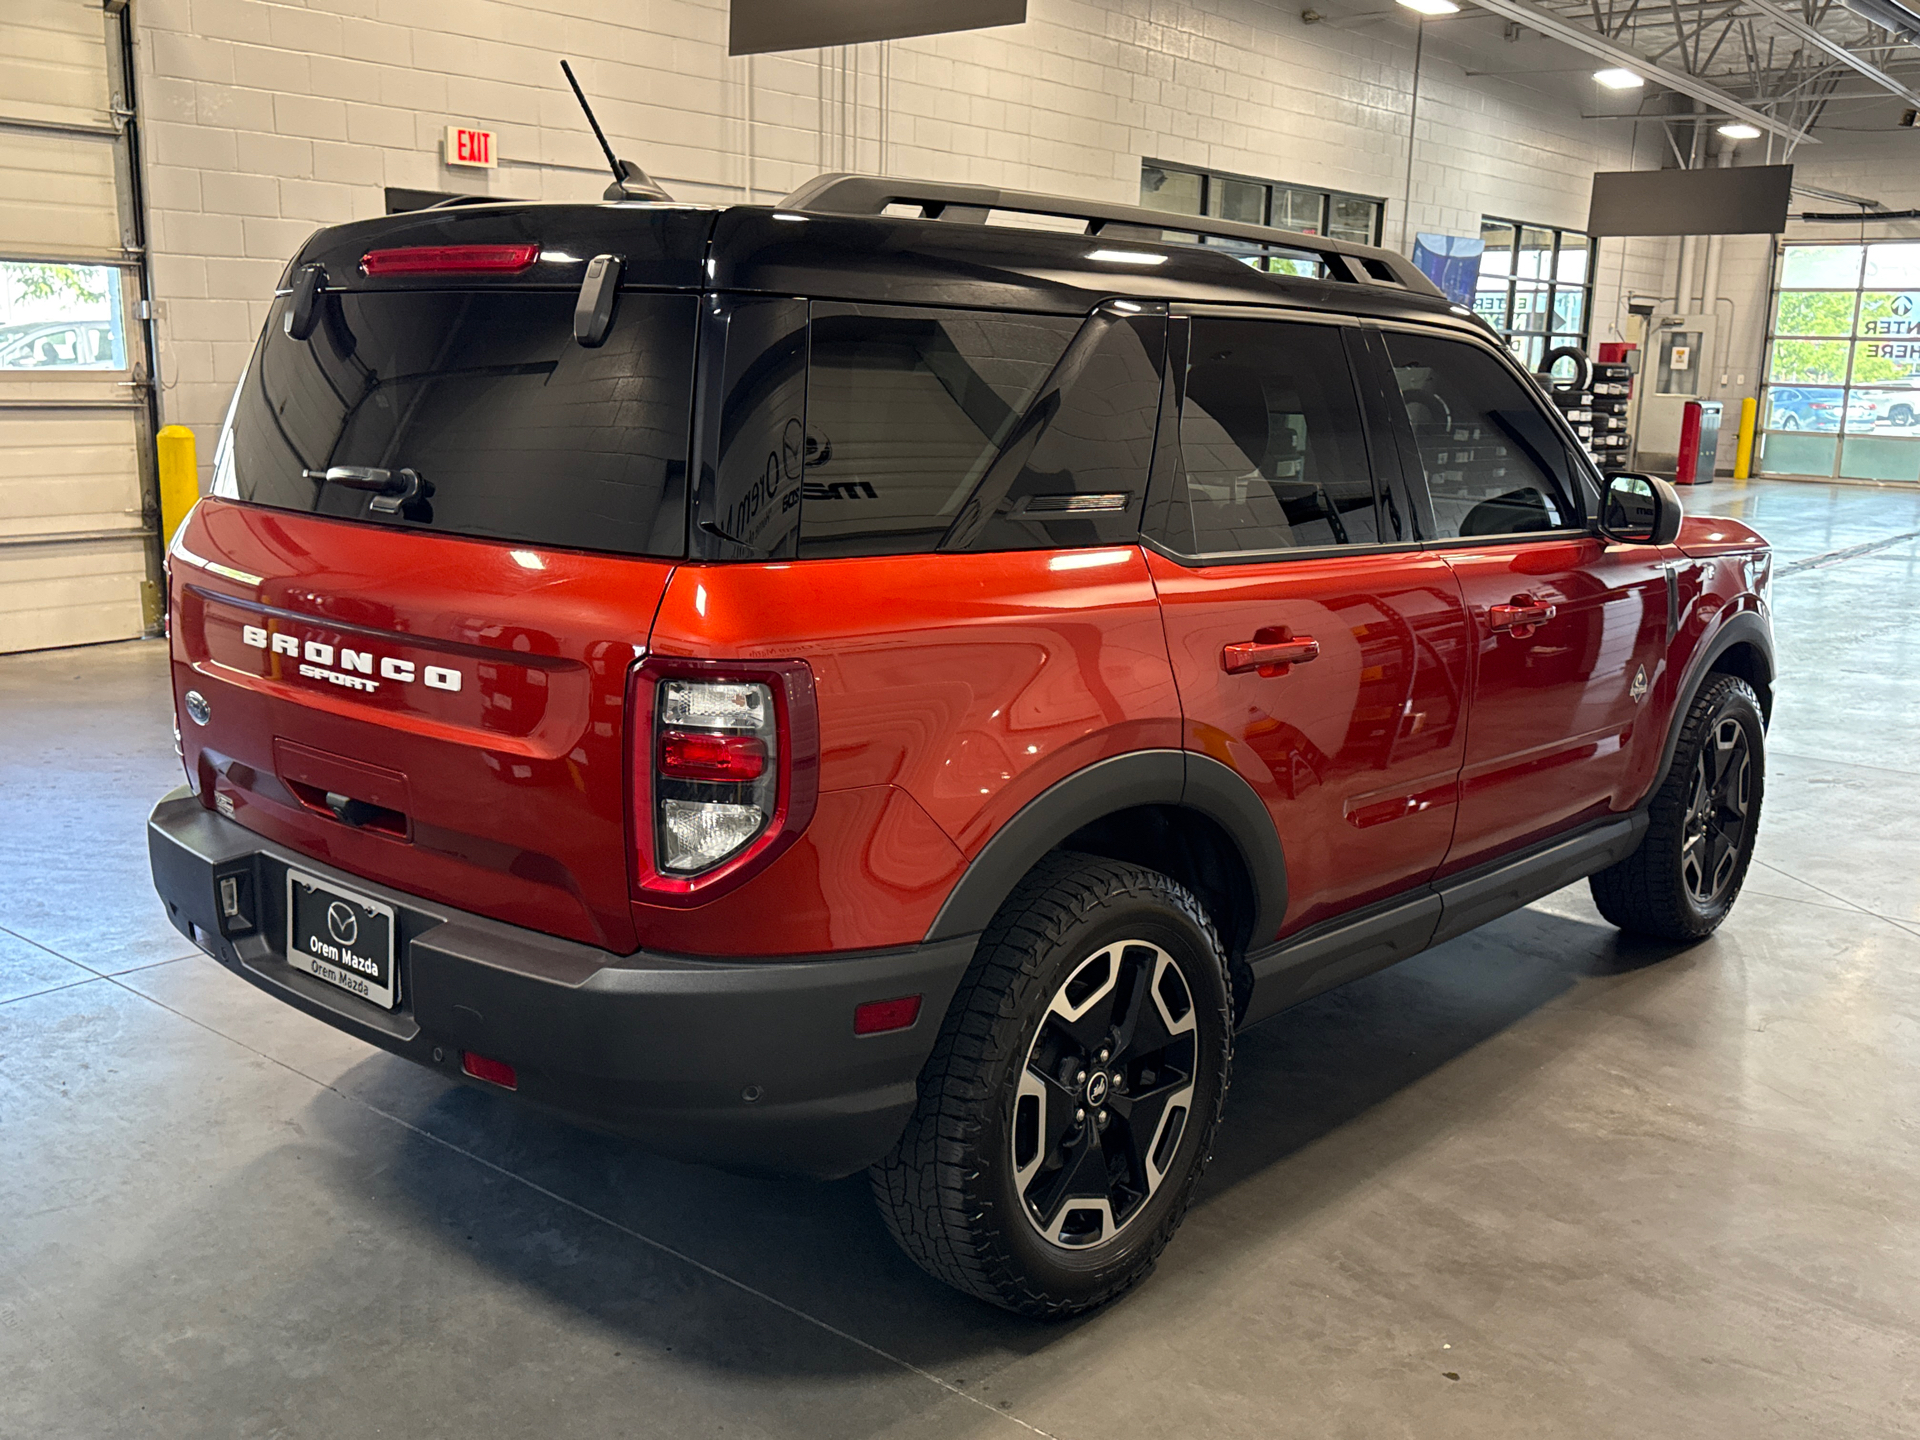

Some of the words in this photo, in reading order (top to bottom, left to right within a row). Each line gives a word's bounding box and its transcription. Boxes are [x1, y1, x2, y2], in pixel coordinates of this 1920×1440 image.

[457, 129, 490, 163] EXIT
[243, 624, 462, 692] BRONCO
[299, 663, 380, 693] SPORT
[309, 935, 339, 961] Orem
[341, 947, 379, 977] Mazda
[310, 959, 337, 982] Orem
[338, 971, 369, 996] Mazda
